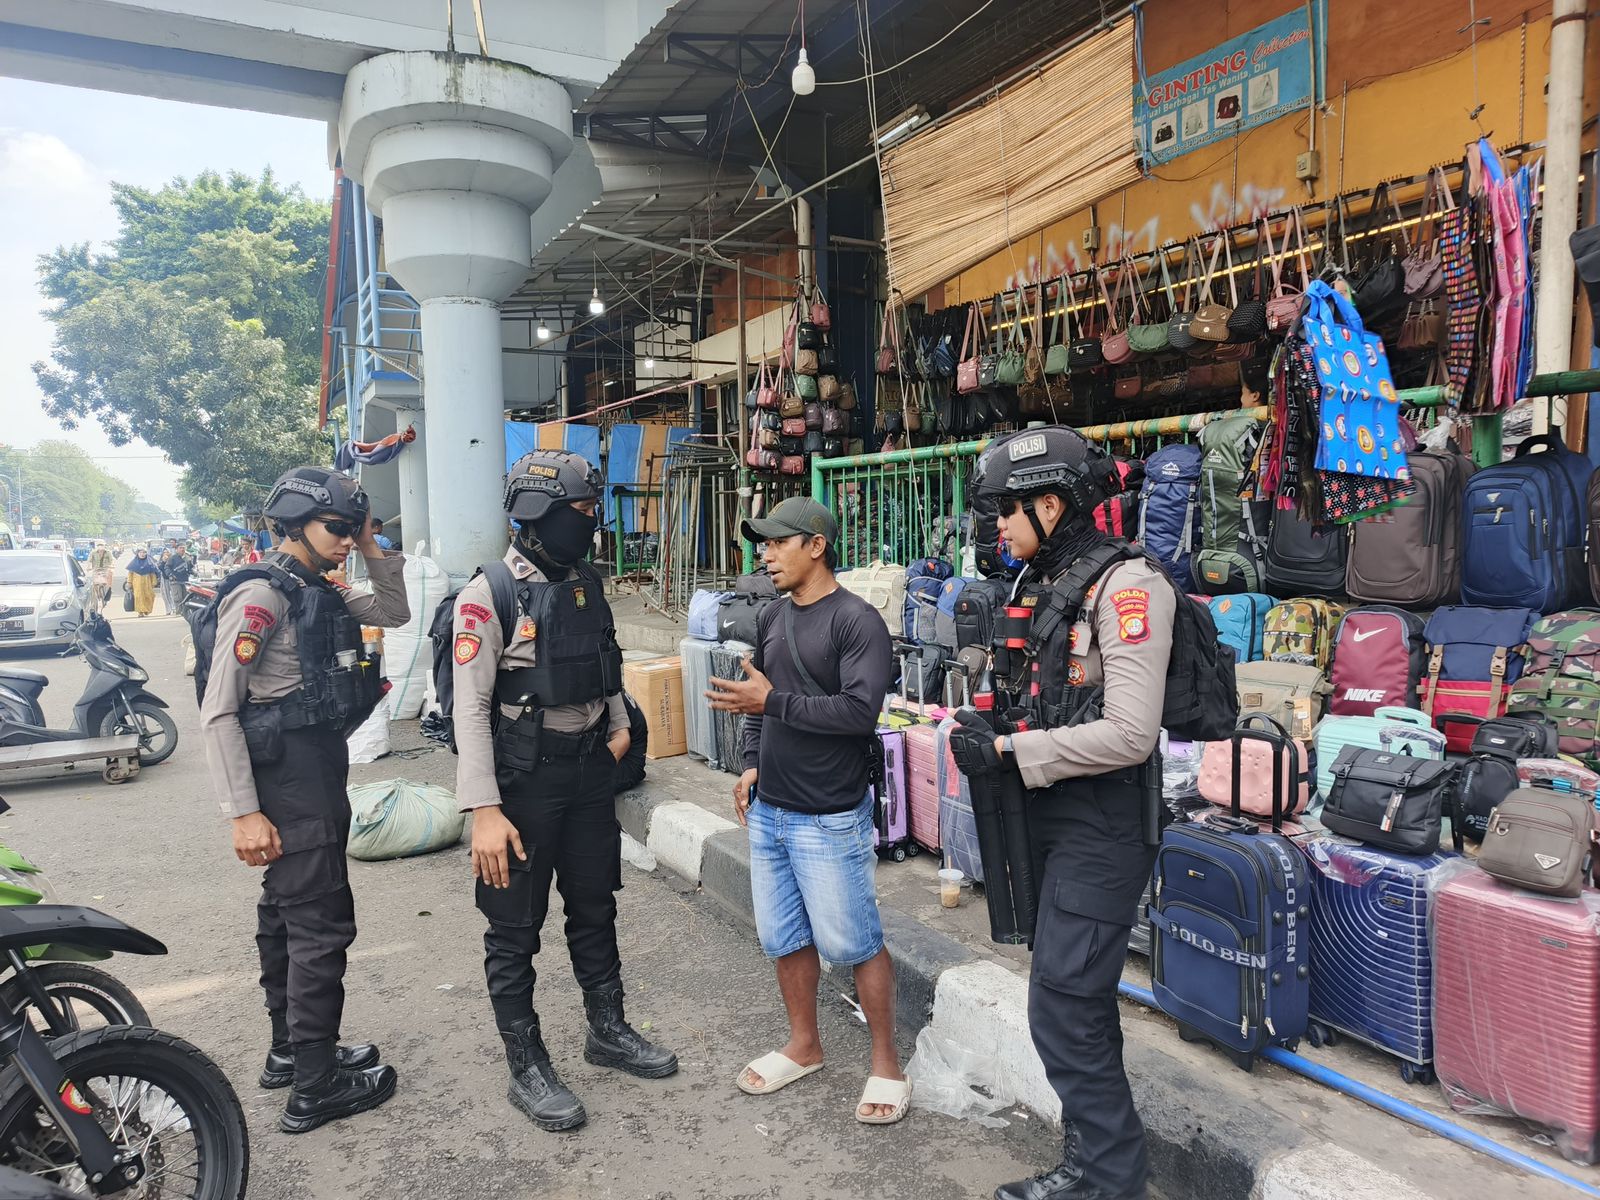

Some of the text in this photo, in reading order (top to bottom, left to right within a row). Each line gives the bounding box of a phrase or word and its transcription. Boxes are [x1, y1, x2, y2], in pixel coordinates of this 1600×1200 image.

[1148, 29, 1311, 108] GINTING Collection
[1163, 90, 1200, 112] Berbagai
[1203, 83, 1217, 95] Tas
[1013, 438, 1043, 457] POLISI
[528, 465, 557, 477] POLISI
[1113, 590, 1146, 602] POLDA
[1343, 688, 1387, 703] NIKE
[1268, 842, 1296, 963] POLO BEN
[1220, 946, 1267, 969] BEN
